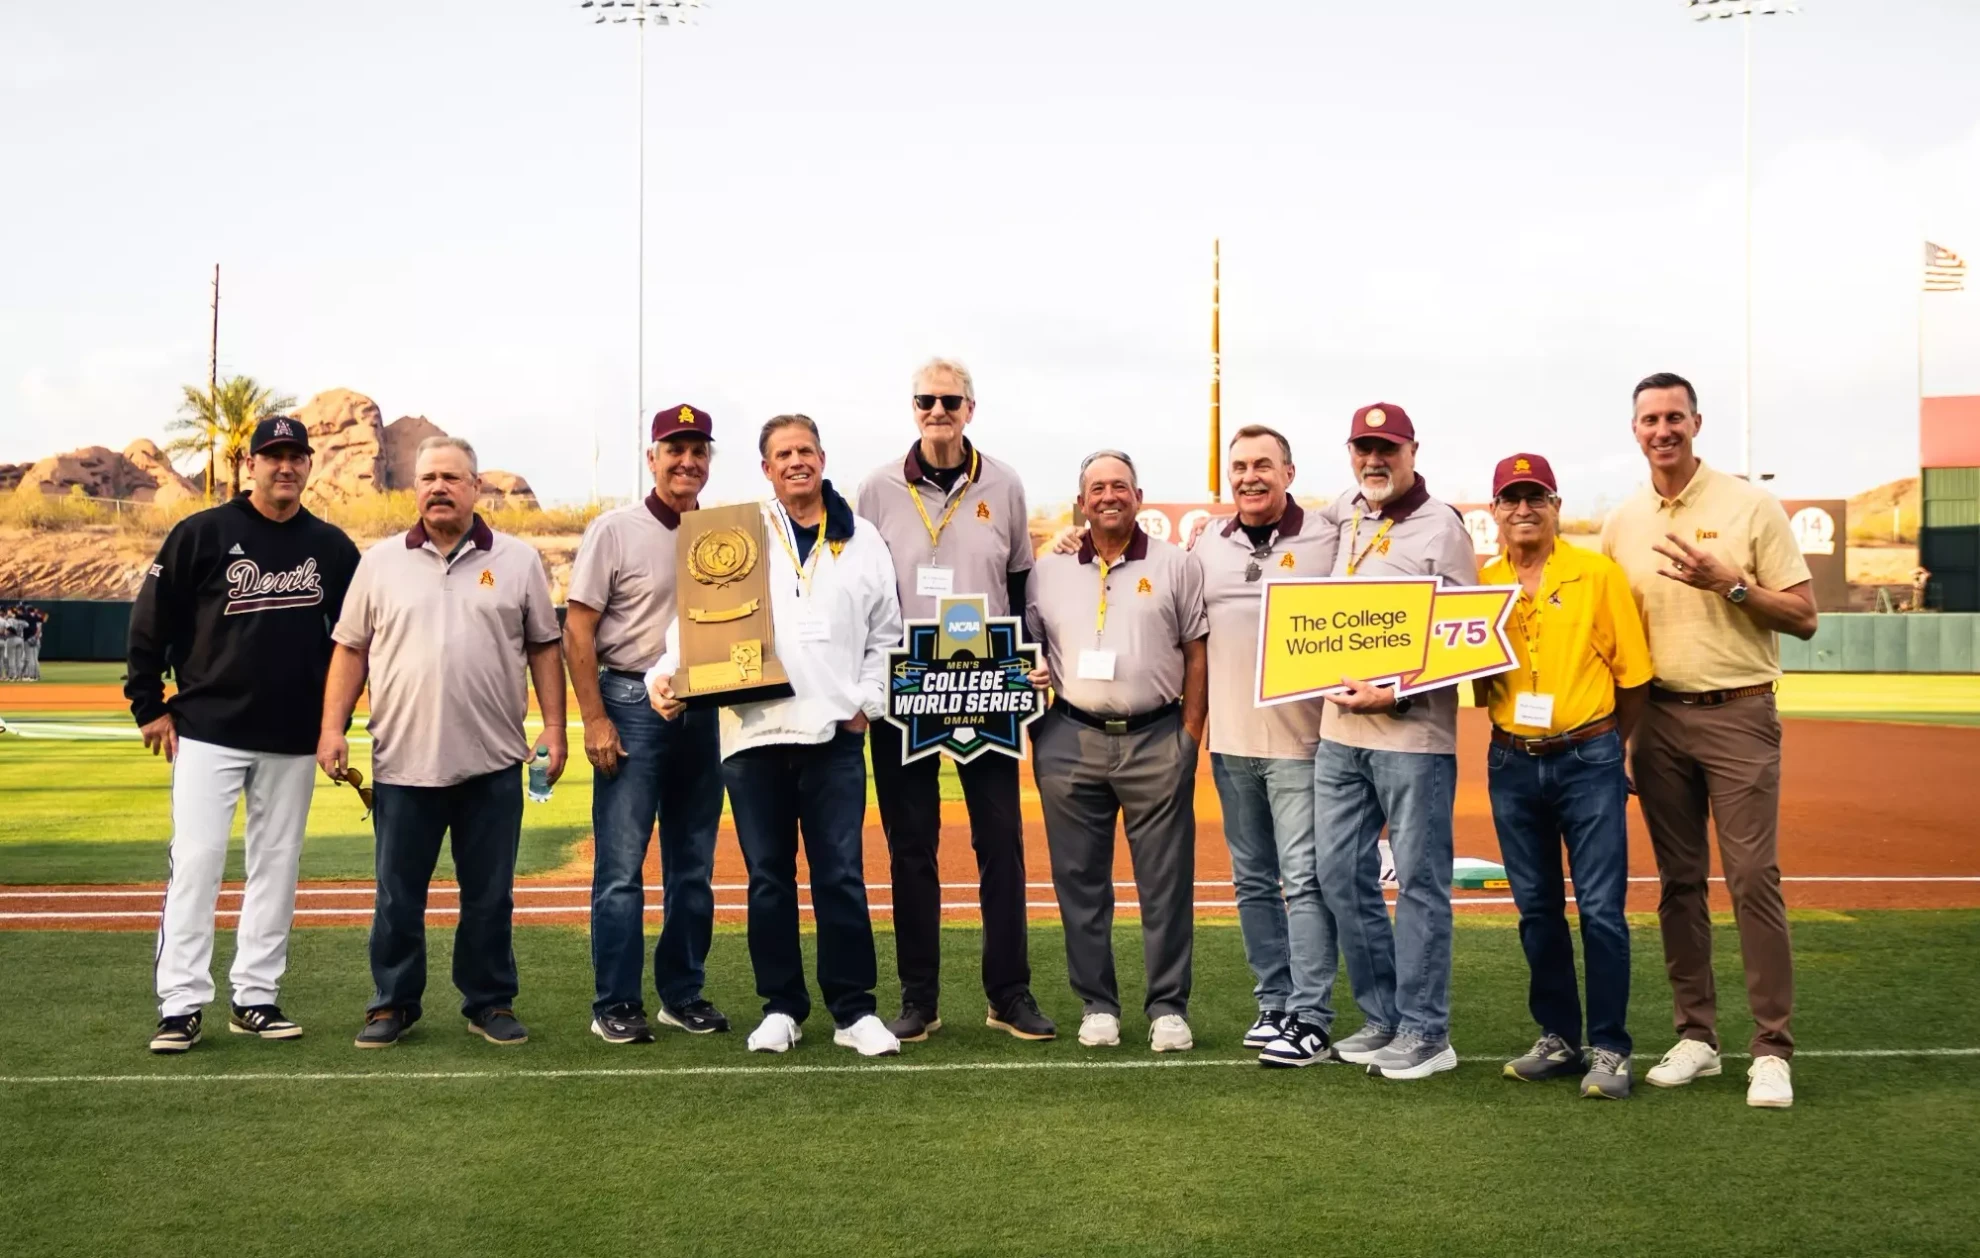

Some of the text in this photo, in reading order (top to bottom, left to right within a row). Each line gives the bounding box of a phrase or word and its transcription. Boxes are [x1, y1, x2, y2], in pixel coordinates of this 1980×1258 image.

[1468, 518, 1487, 535] 14
[1801, 516, 1822, 535] 14
[226, 557, 323, 600] Devils
[947, 621, 980, 633] NCAA
[1289, 609, 1407, 632] The College
[1286, 631, 1412, 656] World Series
[1434, 620, 1487, 646] '75
[946, 660, 980, 670] MEN'S
[922, 670, 1006, 693] COLLEGE
[894, 693, 963, 715] WORLD
[943, 715, 986, 725] OMAHA
